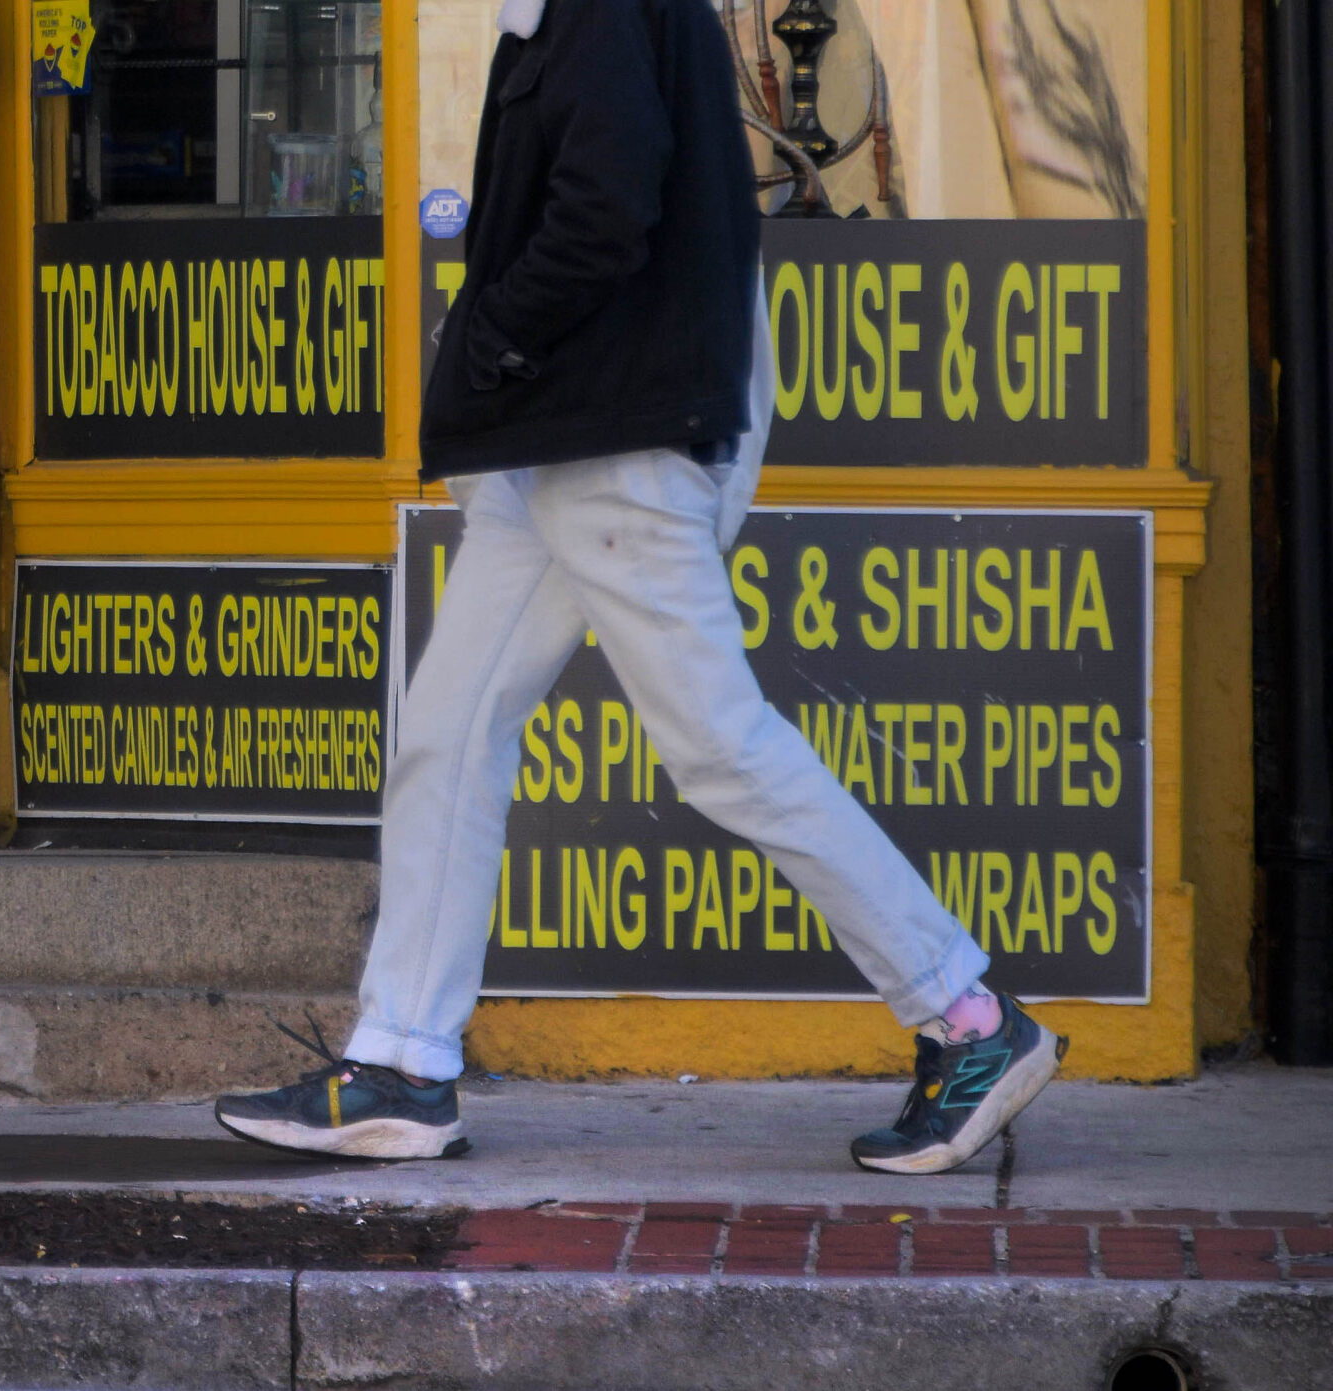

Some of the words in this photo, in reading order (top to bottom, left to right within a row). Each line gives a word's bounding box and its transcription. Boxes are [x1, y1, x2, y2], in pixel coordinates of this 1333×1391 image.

[71, 15, 87, 32] TOP
[427, 199, 462, 217] ADT
[41, 260, 180, 419] TOBACCO
[188, 258, 287, 416] HOUSE
[295, 257, 316, 417] &
[323, 257, 385, 416] GIFT
[763, 262, 922, 421] OUSE
[940, 261, 979, 423] &
[996, 261, 1121, 422] GIFT
[22, 594, 176, 675] LIGHTERS
[186, 594, 208, 677] &
[217, 595, 380, 680] GRINDERS
[793, 546, 839, 651] &
[860, 547, 1114, 652] SHISHA
[21, 704, 106, 786] SCENTED
[111, 705, 199, 788] CANDLES
[204, 707, 217, 788] &
[221, 707, 253, 789] AIR
[258, 708, 380, 794] FRESHENERS
[799, 703, 969, 806] WATER
[984, 703, 1122, 807] PIPES
[488, 847, 646, 951] LLING
[664, 848, 833, 952] PAPER
[932, 850, 1118, 956] WRAPS
